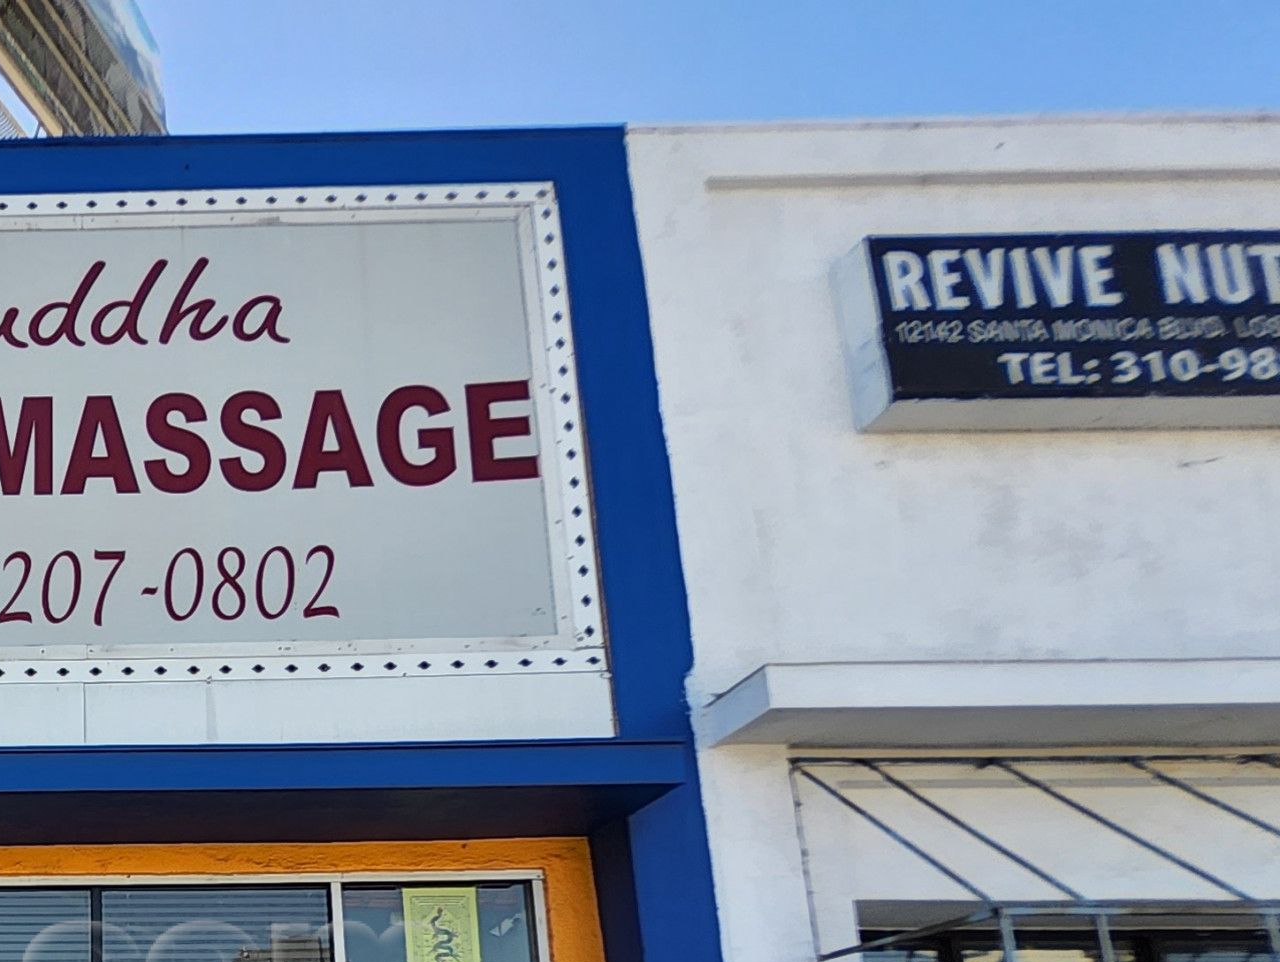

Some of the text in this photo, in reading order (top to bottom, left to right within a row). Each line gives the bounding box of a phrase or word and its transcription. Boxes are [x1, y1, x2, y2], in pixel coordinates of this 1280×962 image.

[882, 242, 1280, 312] REVIVE NUT
[895, 318, 965, 344] 12142
[968, 318, 1050, 344] SANTA
[1051, 317, 1154, 343] MONICA
